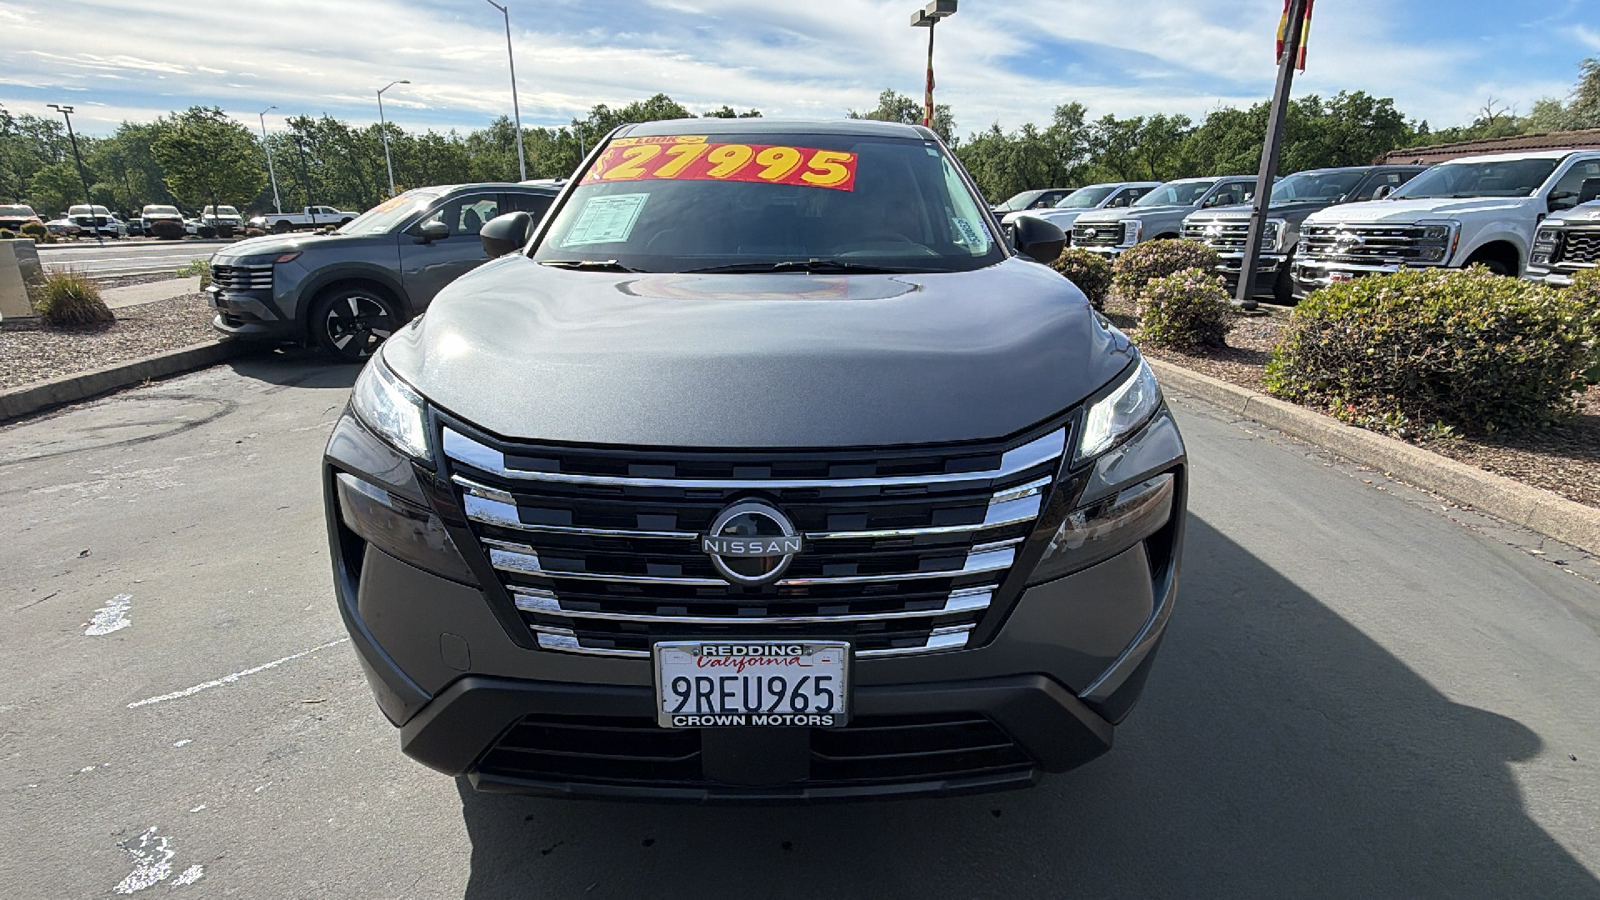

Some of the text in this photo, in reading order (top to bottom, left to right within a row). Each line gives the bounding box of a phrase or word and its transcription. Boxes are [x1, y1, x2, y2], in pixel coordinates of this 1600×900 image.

[704, 539, 799, 554] NISSAN
[702, 645, 802, 656] REDDING
[696, 655, 813, 674] California
[671, 675, 834, 714] 9REU965
[673, 714, 834, 726] CROWN MOTORS
